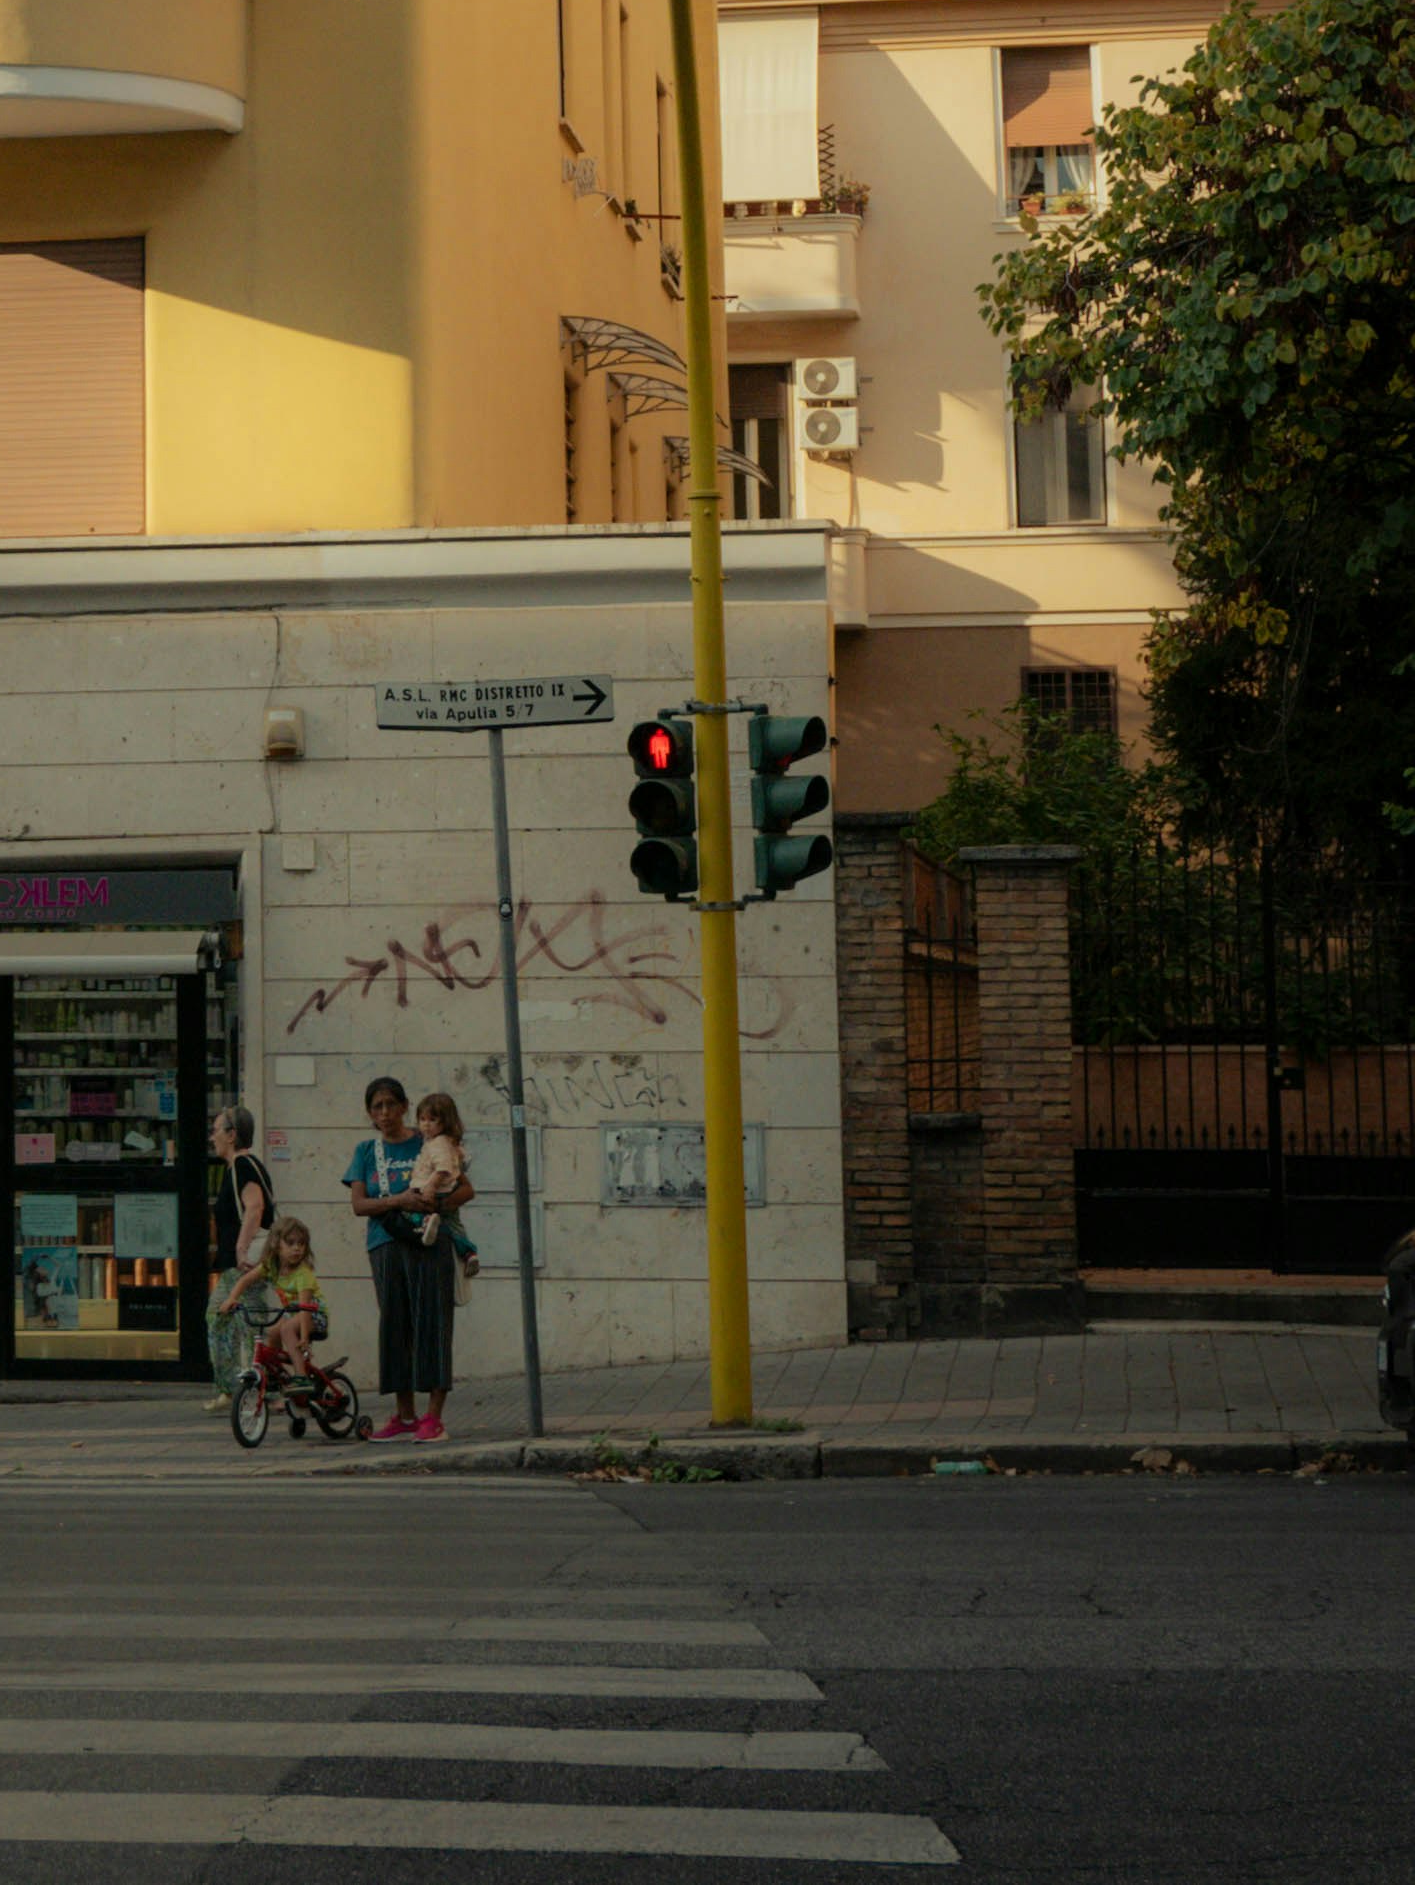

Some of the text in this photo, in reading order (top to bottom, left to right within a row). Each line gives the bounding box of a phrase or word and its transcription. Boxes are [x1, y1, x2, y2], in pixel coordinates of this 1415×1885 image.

[384, 683, 565, 703] A.S.L. RMC DISTRETTO IX
[416, 706, 438, 720] via
[446, 704, 498, 722] Apulia
